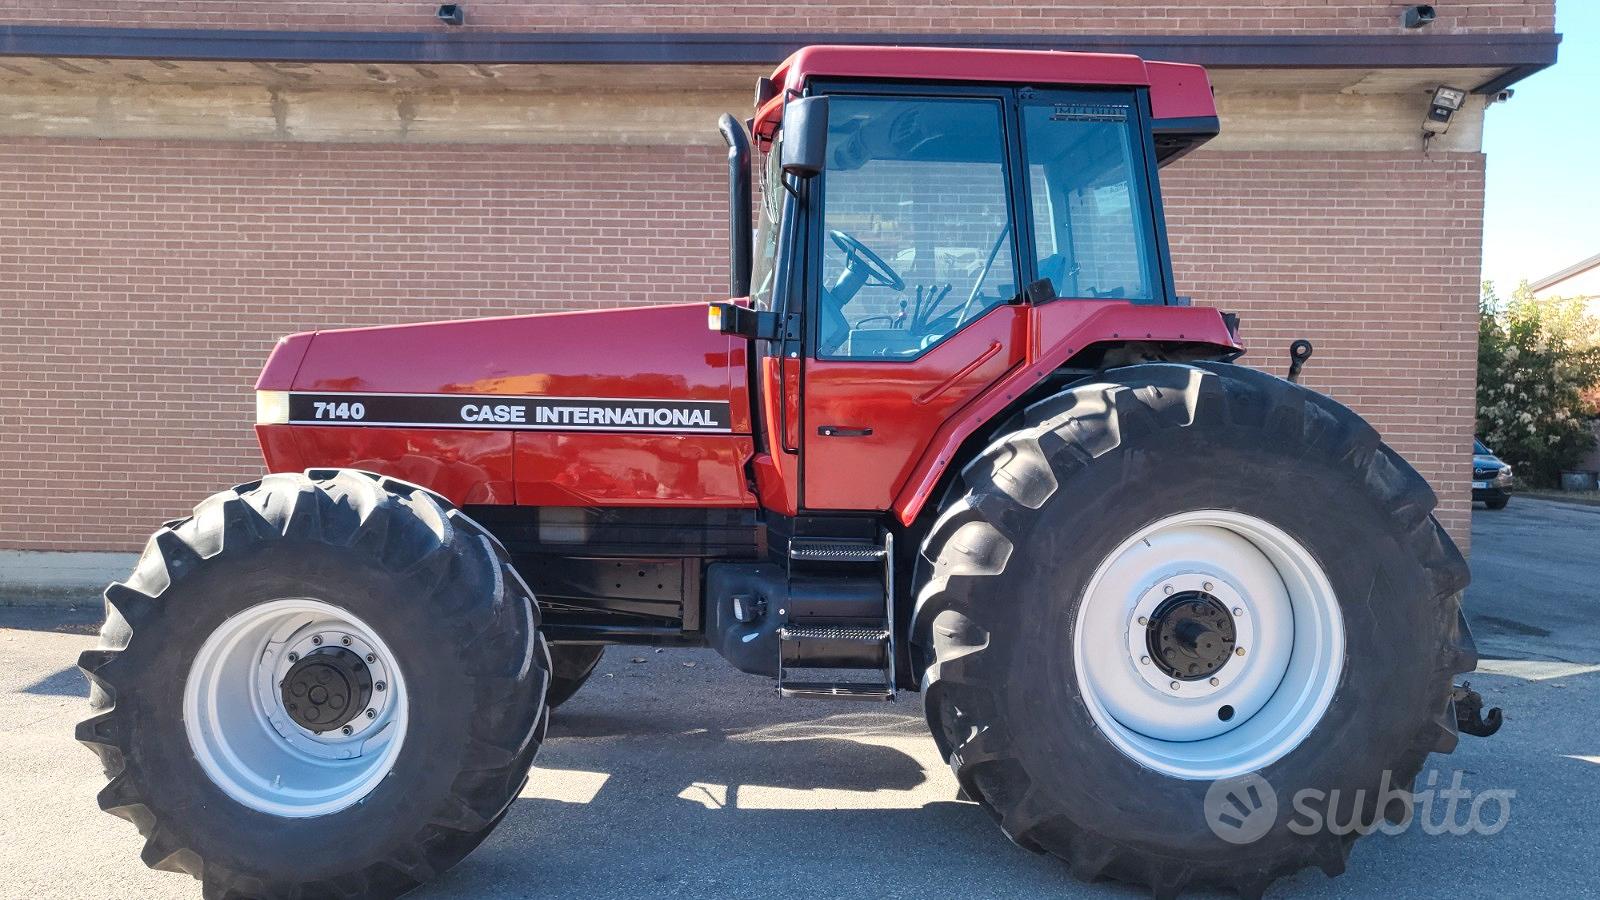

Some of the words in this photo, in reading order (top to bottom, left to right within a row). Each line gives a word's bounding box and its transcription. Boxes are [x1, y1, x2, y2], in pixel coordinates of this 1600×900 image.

[313, 402, 365, 420] 7140
[460, 404, 526, 422] CASE
[535, 406, 718, 426] INTERNATIONAL
